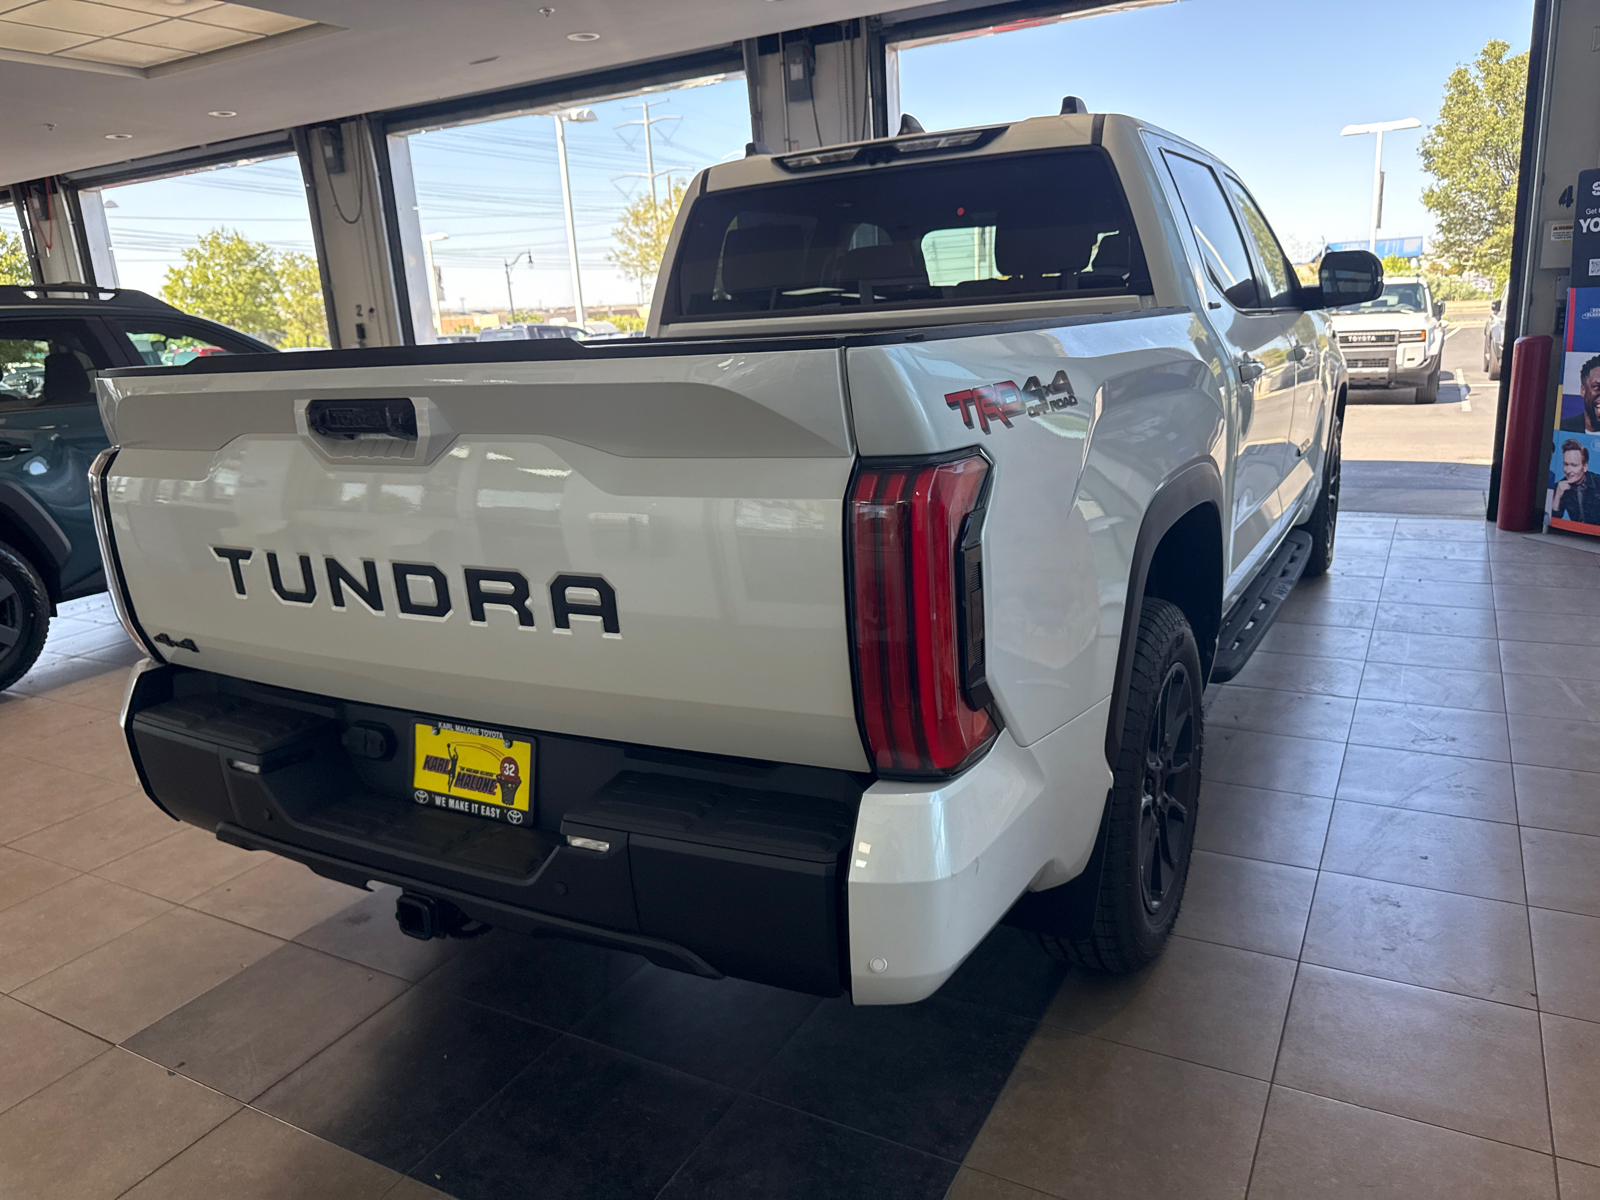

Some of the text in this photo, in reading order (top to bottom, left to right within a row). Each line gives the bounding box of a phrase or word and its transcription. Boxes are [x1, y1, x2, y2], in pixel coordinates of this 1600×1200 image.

[1558, 185, 1574, 209] 4
[1585, 208, 1597, 216] Get
[944, 380, 1027, 436] TRD
[1027, 395, 1078, 418] OFF ROAD
[210, 545, 622, 639] TUNDRA
[438, 722, 504, 740] KARL MALONE TOYOTA
[422, 754, 450, 775] KARL
[503, 762, 516, 777] 32
[454, 772, 498, 796] MALONE
[434, 795, 501, 819] WE MAKE IT EASY
